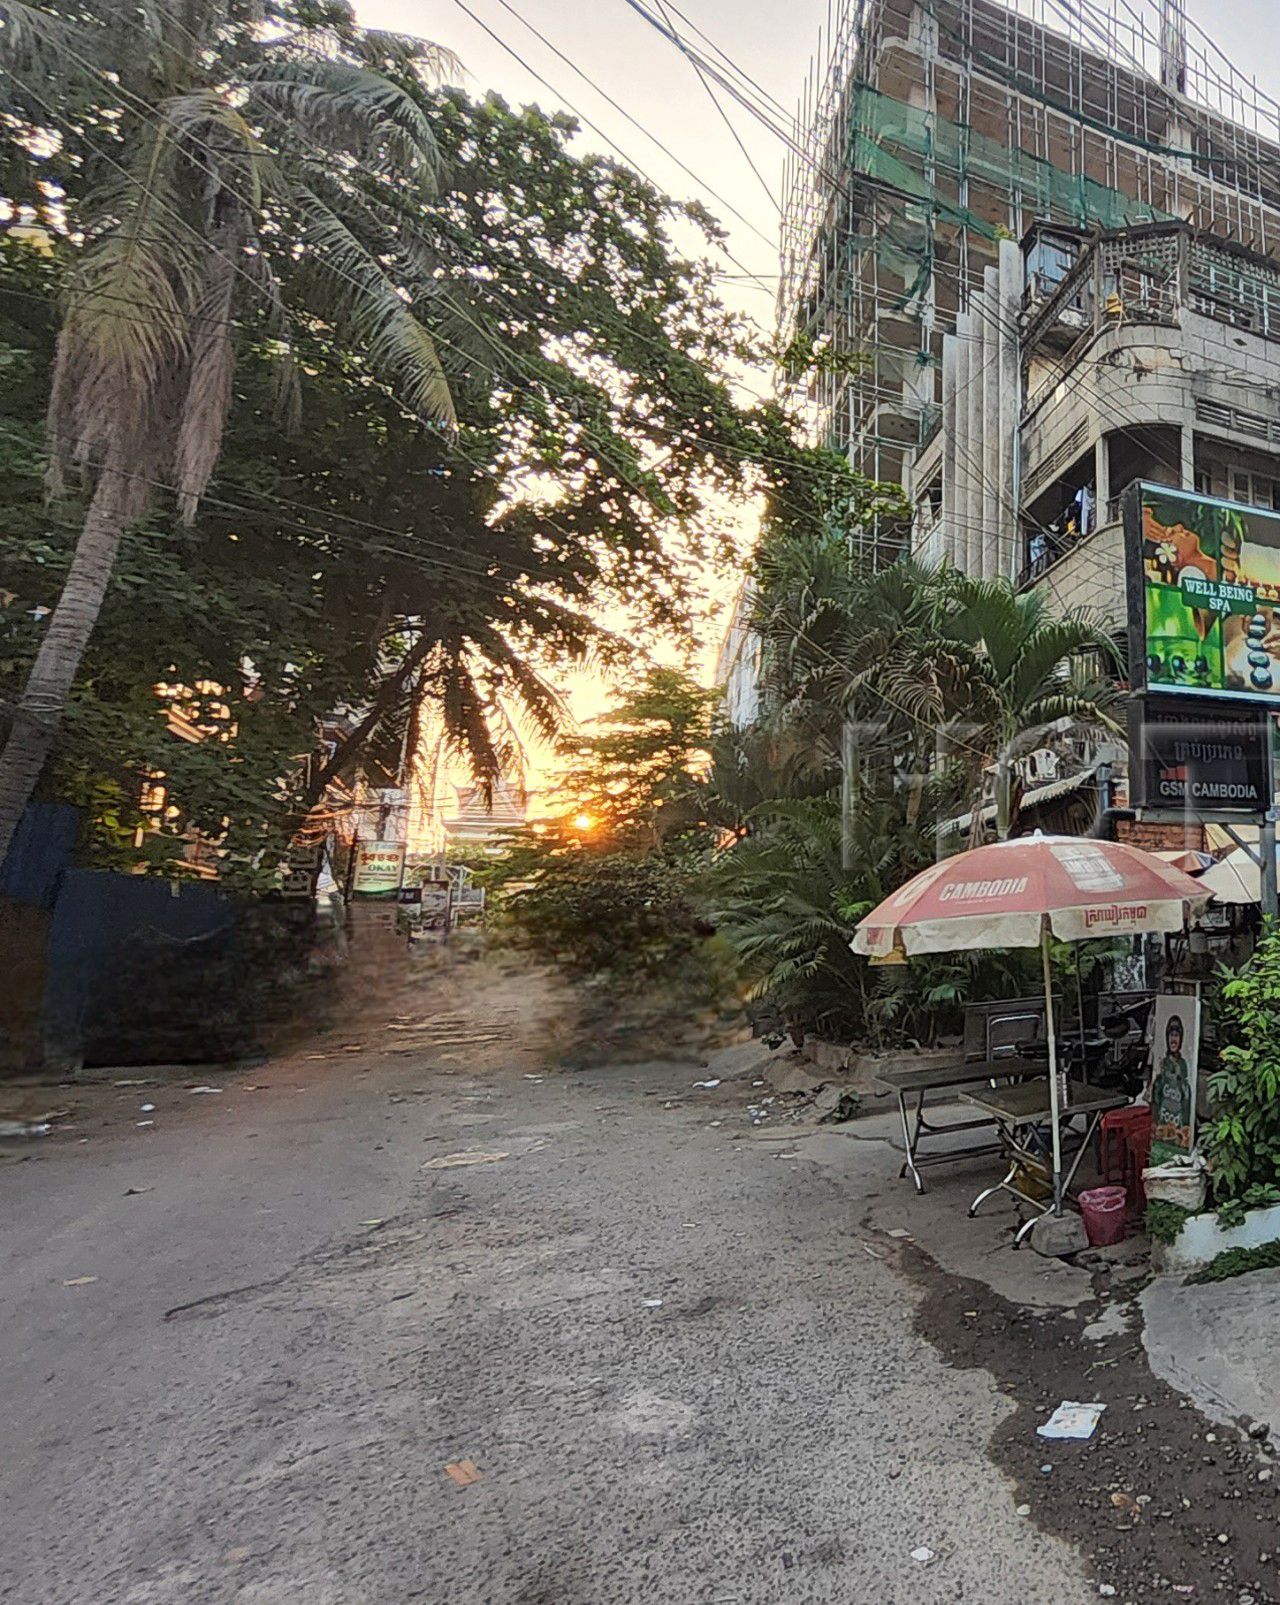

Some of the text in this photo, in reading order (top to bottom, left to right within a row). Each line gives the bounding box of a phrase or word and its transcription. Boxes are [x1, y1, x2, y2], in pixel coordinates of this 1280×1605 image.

[1184, 578, 1254, 603] WELL BEING
[1208, 597, 1232, 613] SPA
[1159, 780, 1258, 799] GSM CAMBODIA
[938, 876, 1029, 902] CAMBODIA
[1162, 1083, 1183, 1103] Grab
[1158, 1106, 1183, 1127] Food
